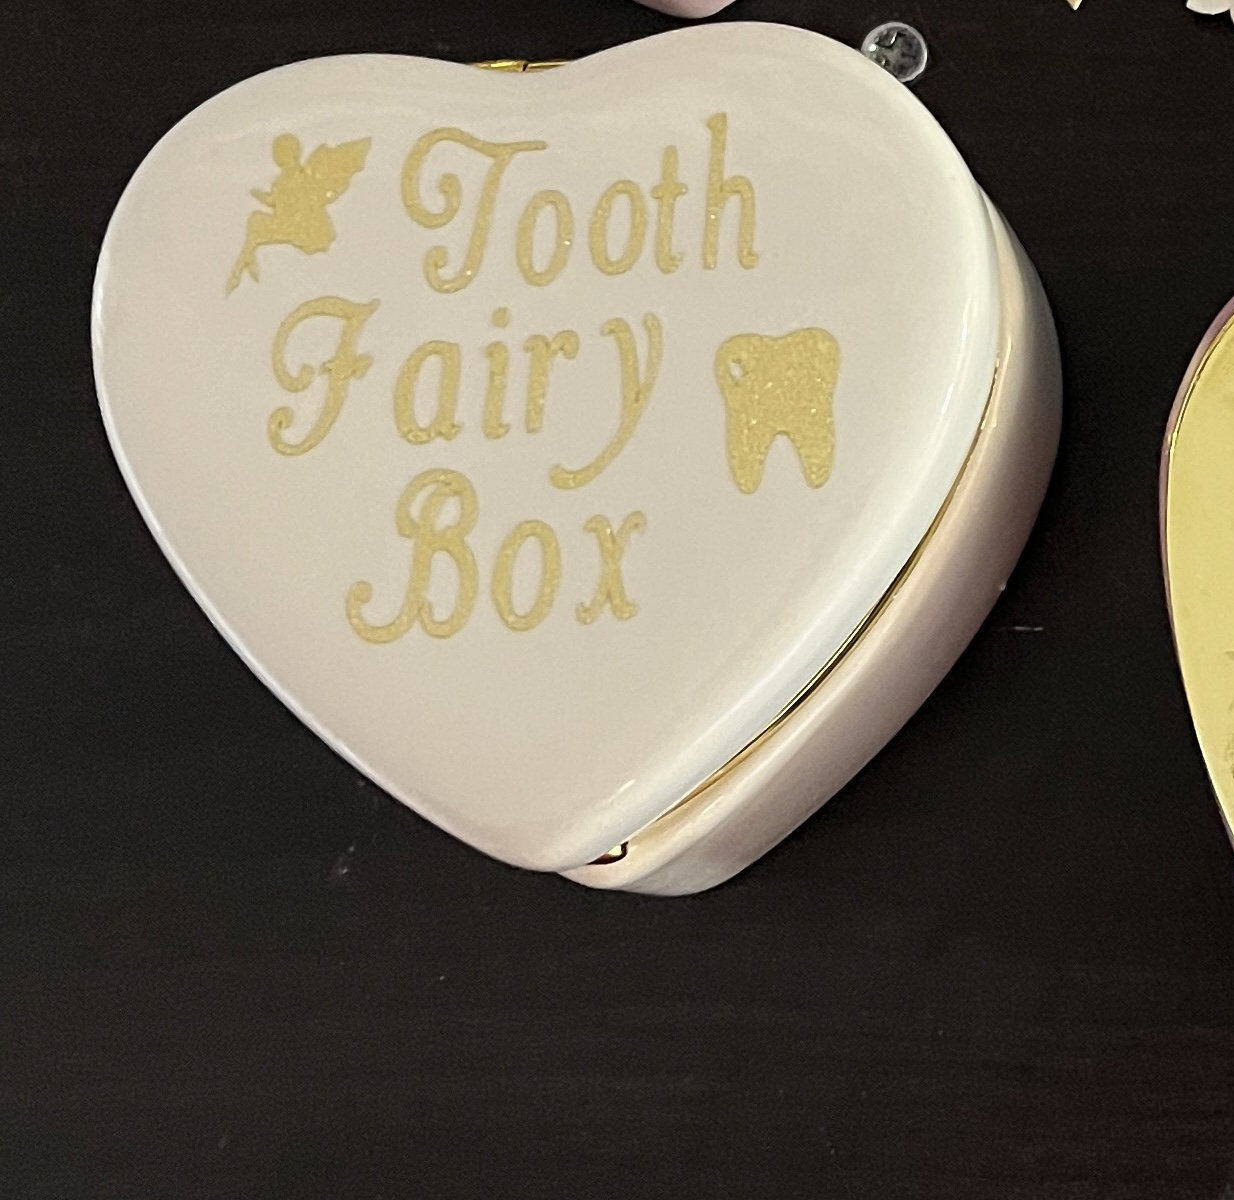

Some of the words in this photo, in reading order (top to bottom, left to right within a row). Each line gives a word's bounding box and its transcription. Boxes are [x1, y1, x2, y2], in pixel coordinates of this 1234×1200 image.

[400, 112, 760, 294] Tooth
[266, 295, 664, 490] Fairy
[345, 467, 648, 646] Box
